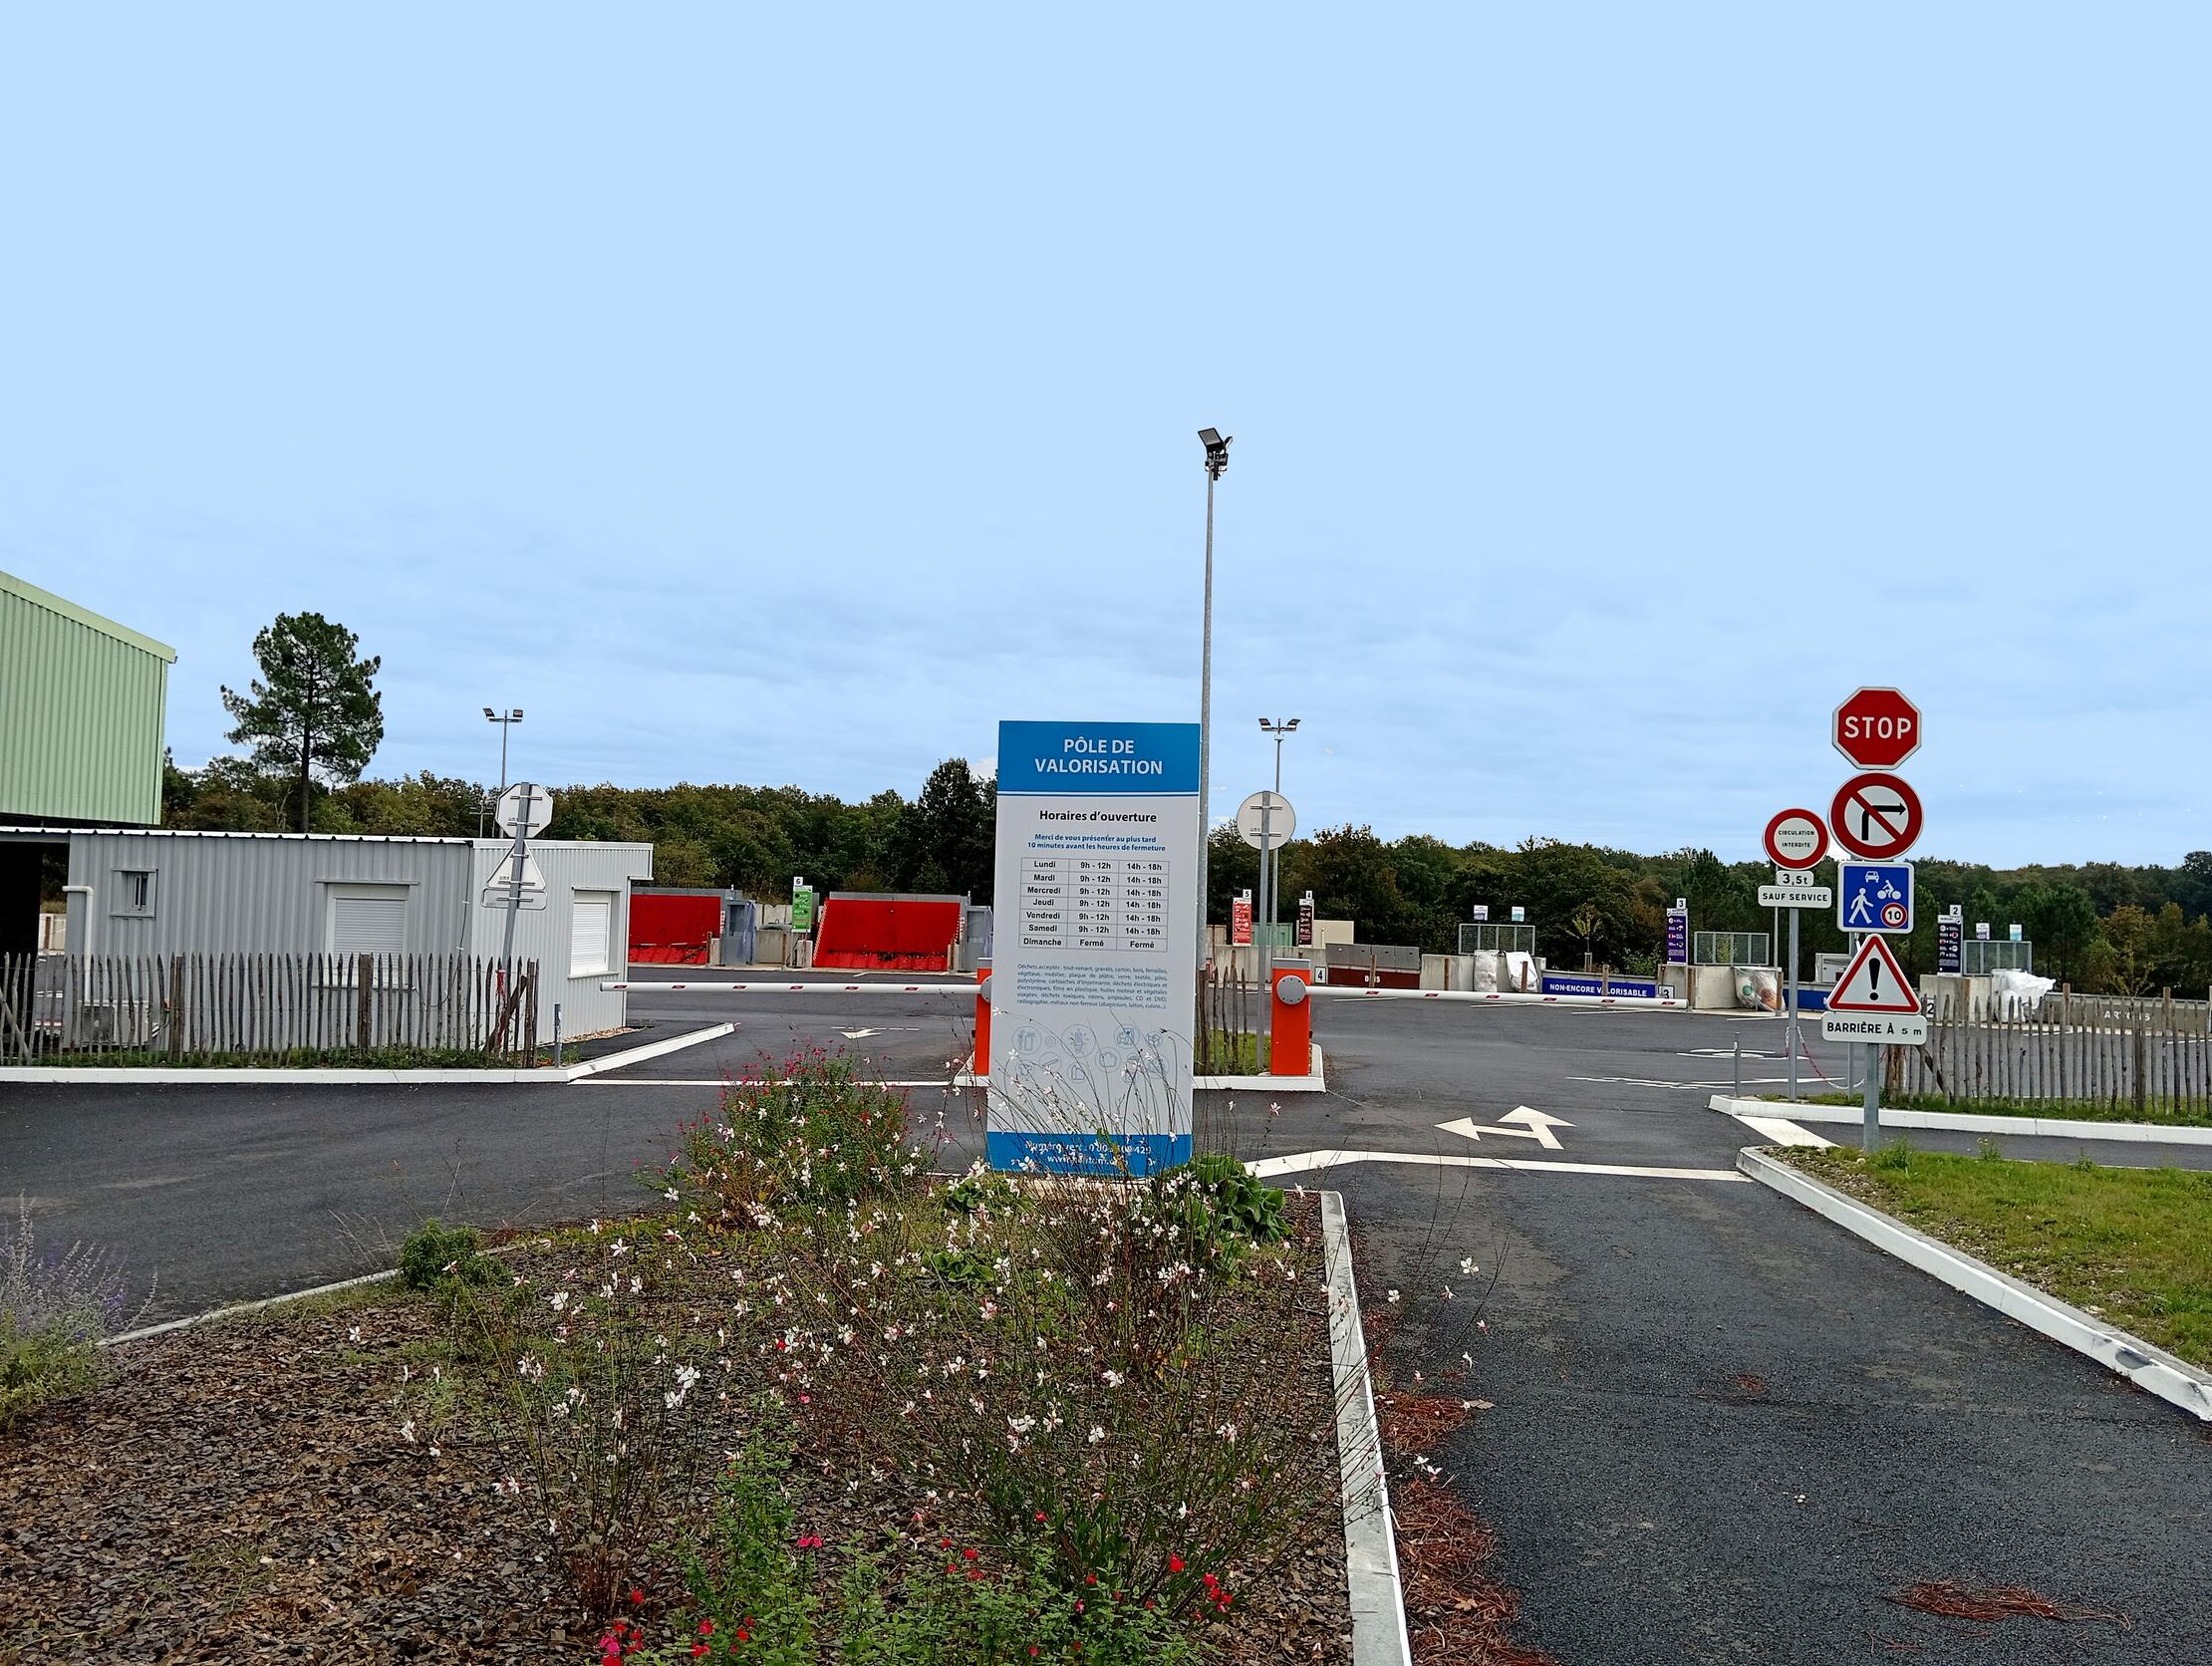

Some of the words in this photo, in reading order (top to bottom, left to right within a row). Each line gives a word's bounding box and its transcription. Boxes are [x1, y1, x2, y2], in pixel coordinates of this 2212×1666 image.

[1844, 716, 1912, 739] STOP
[1064, 736, 1107, 754] PÔLE
[1112, 740, 1134, 754] DE
[1035, 758, 1163, 774] VALORISATION
[1039, 811, 1087, 821] Horaires
[1763, 892, 1786, 901] SAUF
[1789, 892, 1827, 902] SERVICE
[1888, 910, 1901, 921] 10
[1318, 971, 1323, 980] 4
[1549, 983, 1595, 993] NON-ENCORE
[1597, 986, 1647, 996] VORISABLE
[1664, 989, 1669, 998] 3
[1927, 1003, 1934, 1014] 2
[1827, 1020, 1881, 1035] BARRIÈRE
[1887, 1021, 1894, 1035] À
